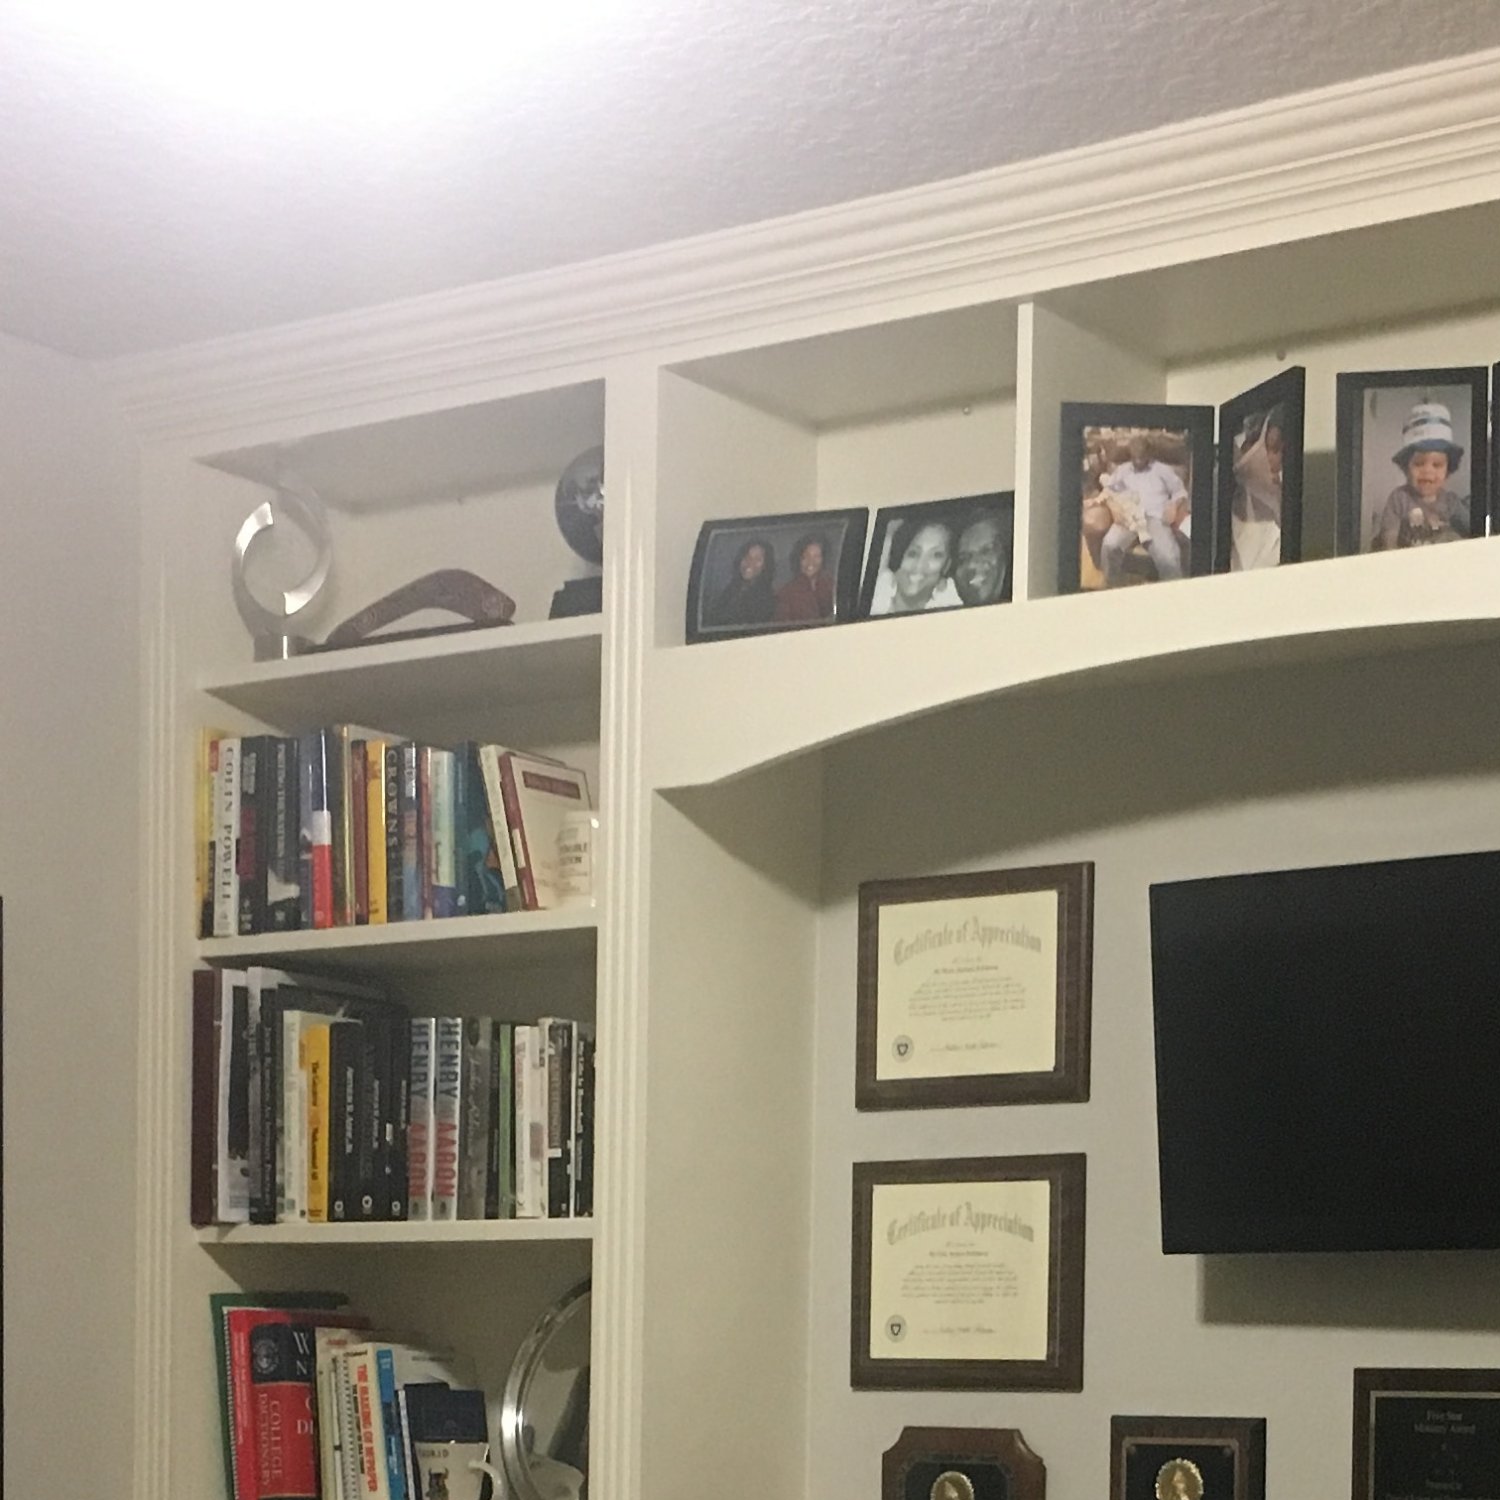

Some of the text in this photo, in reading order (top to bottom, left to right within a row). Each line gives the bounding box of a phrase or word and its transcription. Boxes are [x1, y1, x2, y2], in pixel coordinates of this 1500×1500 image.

[221, 746, 234, 904] COLIN POWELL
[386, 749, 398, 847] CROWNS
[893, 915, 1042, 967] Certificate of Appreciation
[408, 1023, 428, 1198] HENRY AARON
[434, 1022, 459, 1198] HENRY AARON
[887, 1200, 1034, 1246] Certificate of Appreciation
[356, 1364, 368, 1383] THE
[256, 1392, 270, 1486] DICTIONARY
[270, 1400, 283, 1480] COLLEGE
